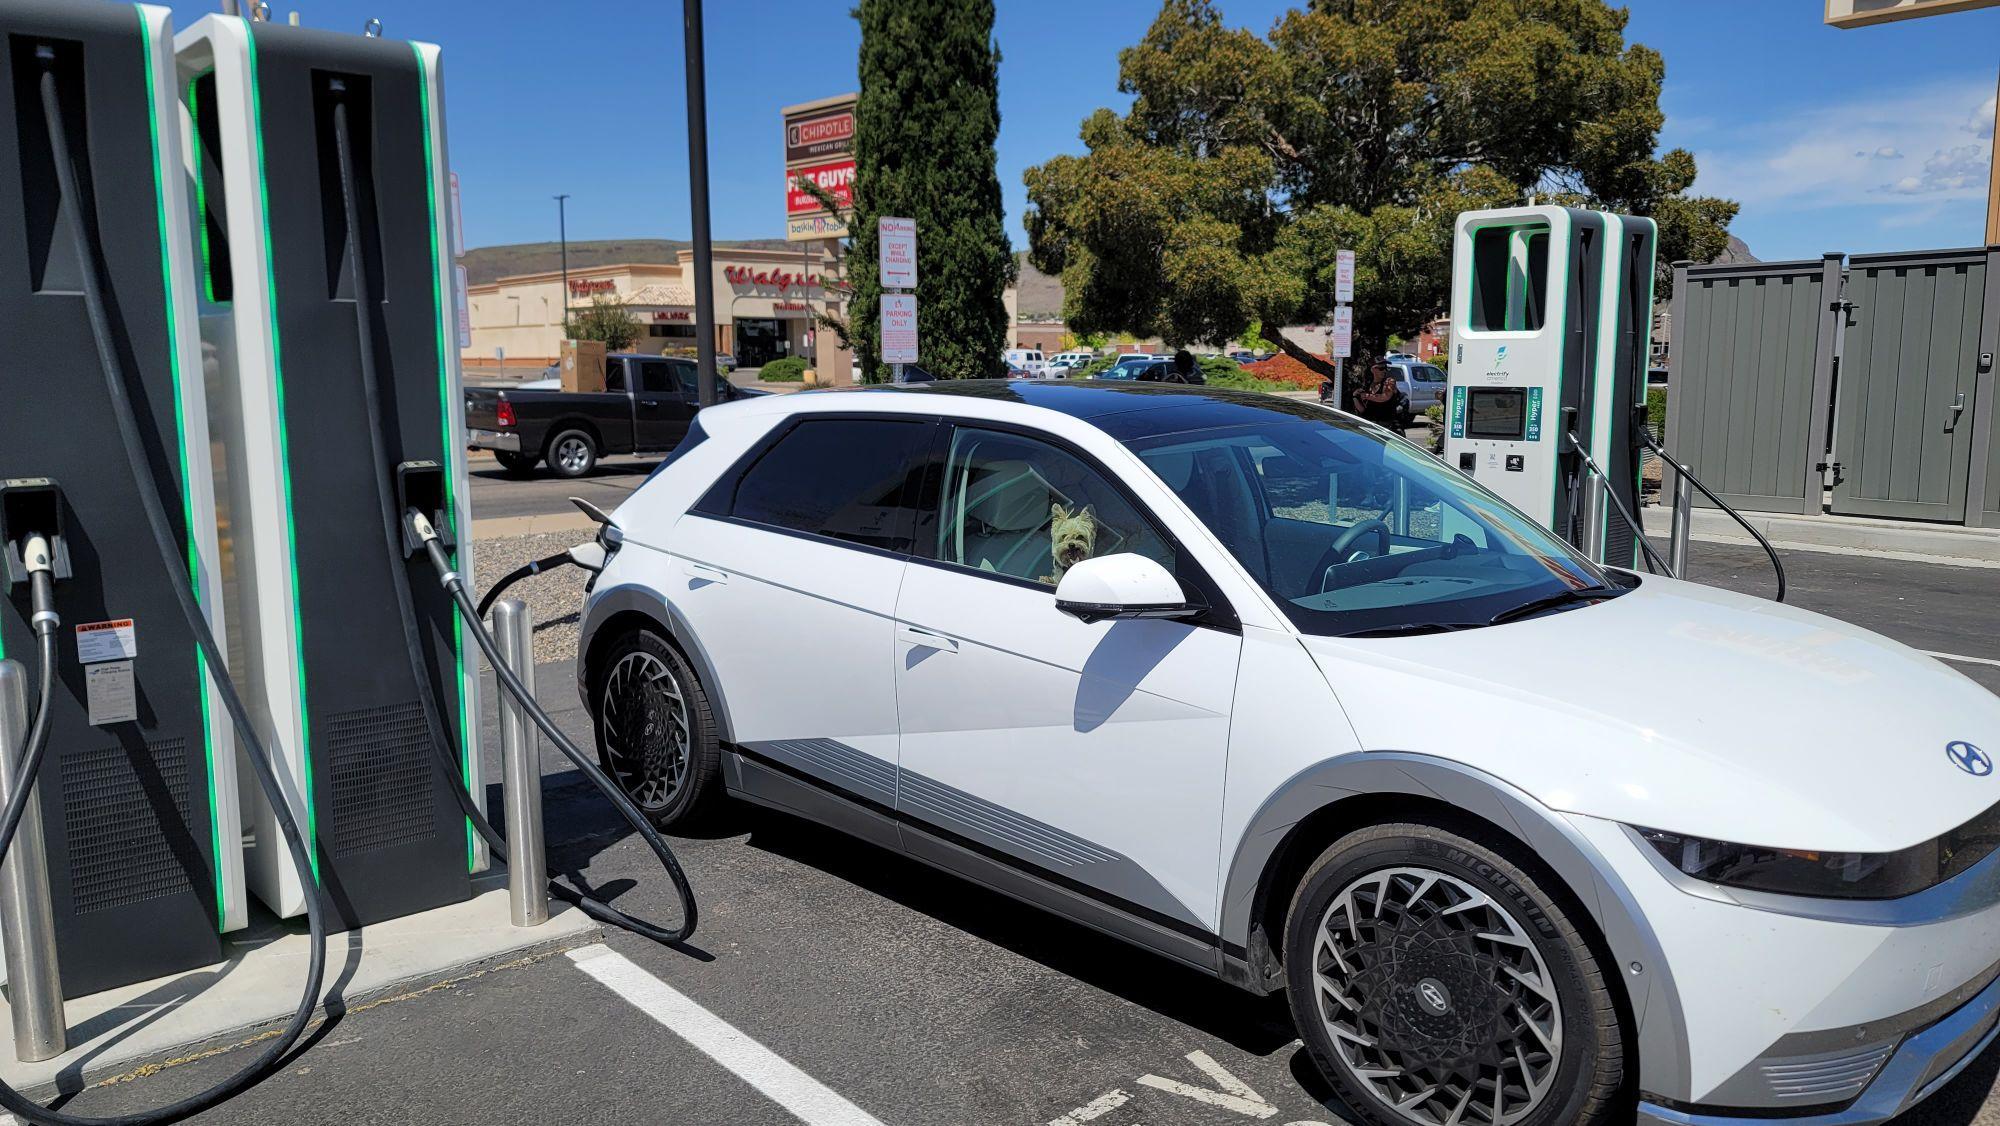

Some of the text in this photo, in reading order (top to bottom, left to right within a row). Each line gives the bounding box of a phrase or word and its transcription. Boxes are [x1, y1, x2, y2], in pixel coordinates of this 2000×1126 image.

[803, 120, 850, 140] CHIPOTLE
[810, 143, 833, 153] MEXICAN
[787, 167, 855, 192] FIE GUYS
[1486, 371, 1509, 379] electrify
[88, 621, 129, 631] WARNING
[1446, 850, 1555, 939] MICHELIN
